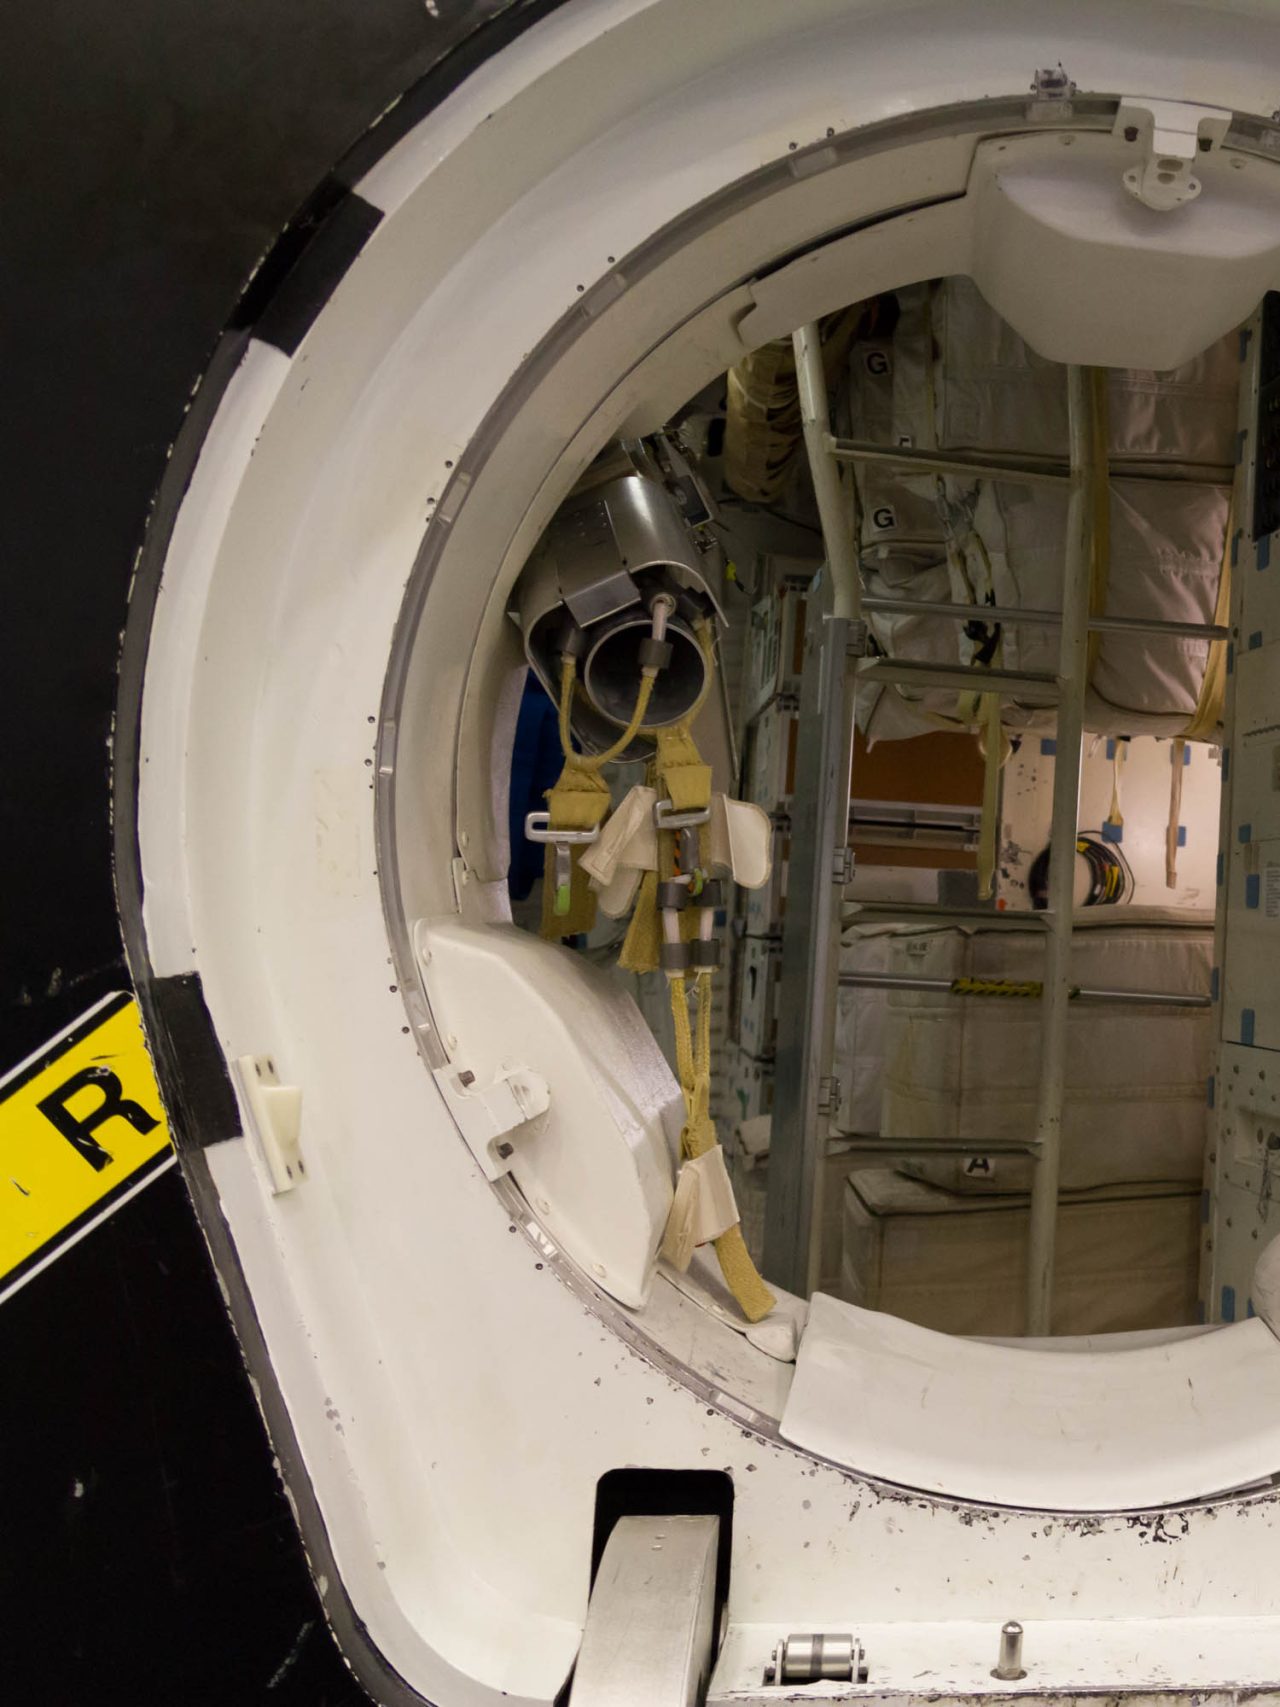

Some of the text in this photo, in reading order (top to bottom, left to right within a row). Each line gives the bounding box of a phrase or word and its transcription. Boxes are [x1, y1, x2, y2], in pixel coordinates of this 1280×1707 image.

[867, 352, 888, 375] G
[873, 508, 895, 528] G
[36, 1066, 161, 1172] R
[966, 1158, 990, 1174] A
